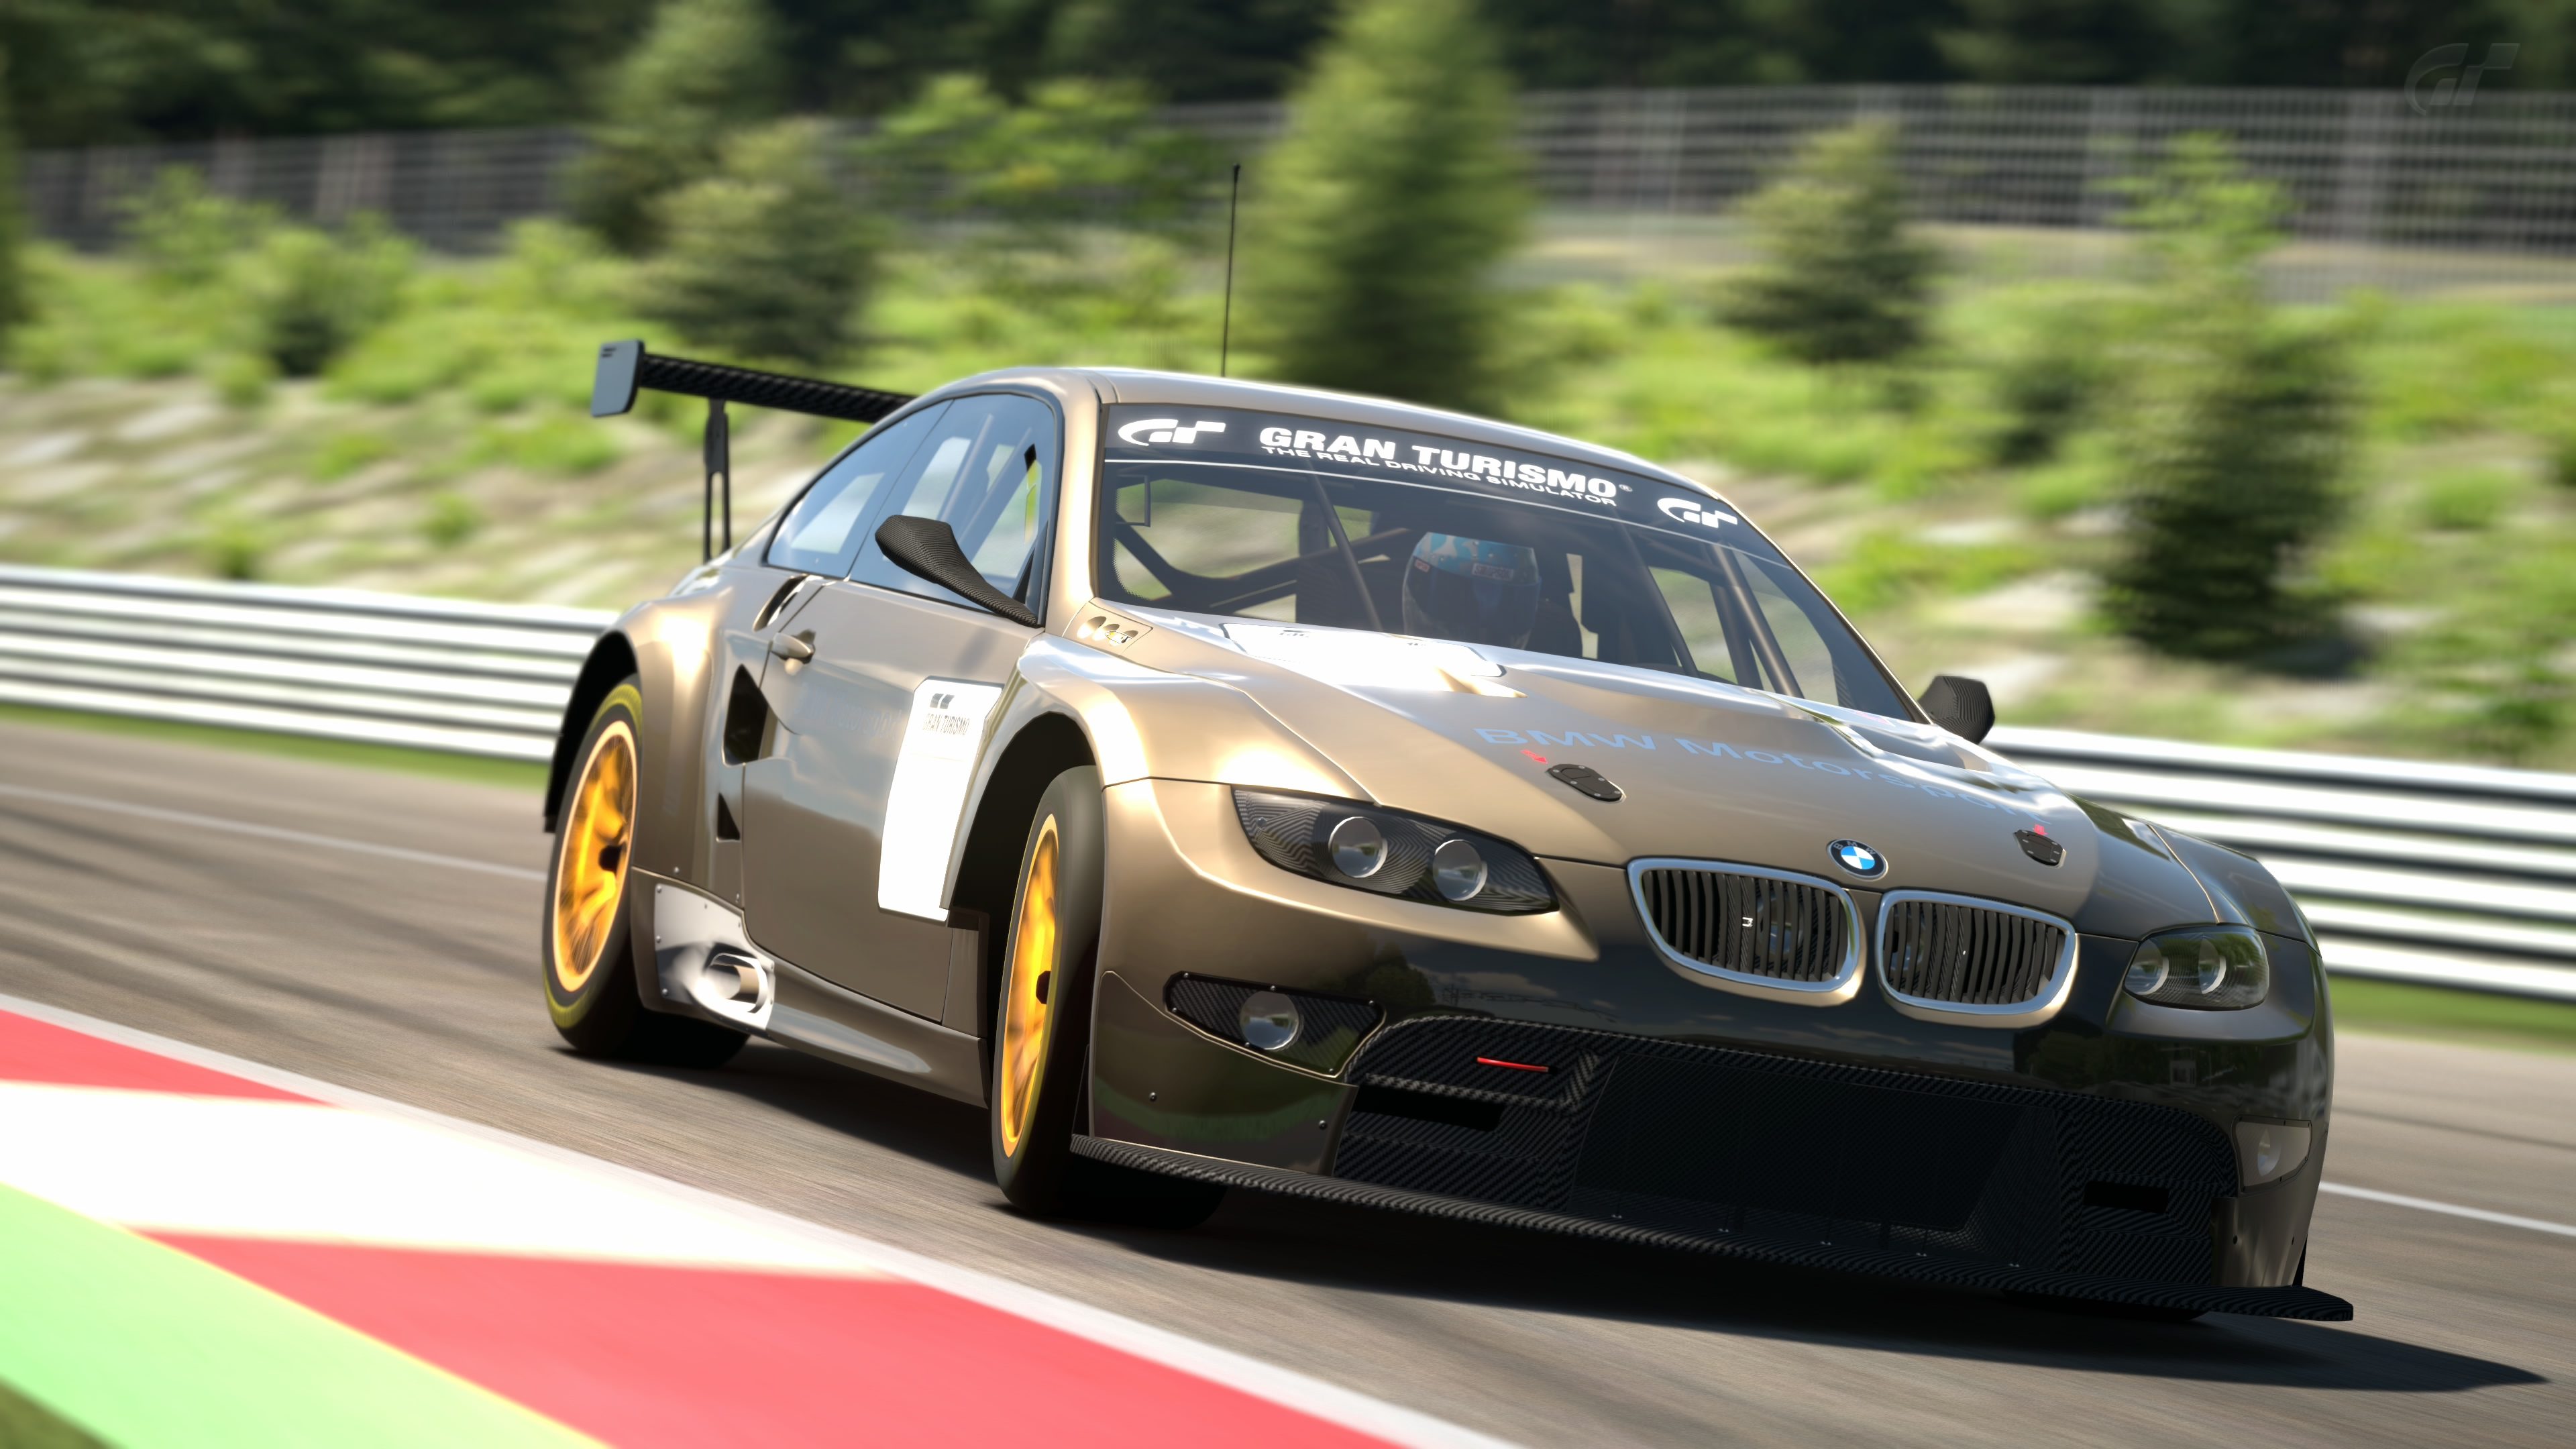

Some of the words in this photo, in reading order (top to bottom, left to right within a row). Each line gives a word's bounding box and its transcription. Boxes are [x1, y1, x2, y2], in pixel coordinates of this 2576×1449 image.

[1259, 427, 1395, 460] GRAN
[1261, 447, 1311, 458] THE
[1317, 452, 1380, 466] REAL
[1385, 460, 1481, 481] DRIVING
[1487, 476, 1617, 506] SIMULATOR
[1473, 728, 1656, 750] BMW
[1833, 841, 1876, 855] BMW
